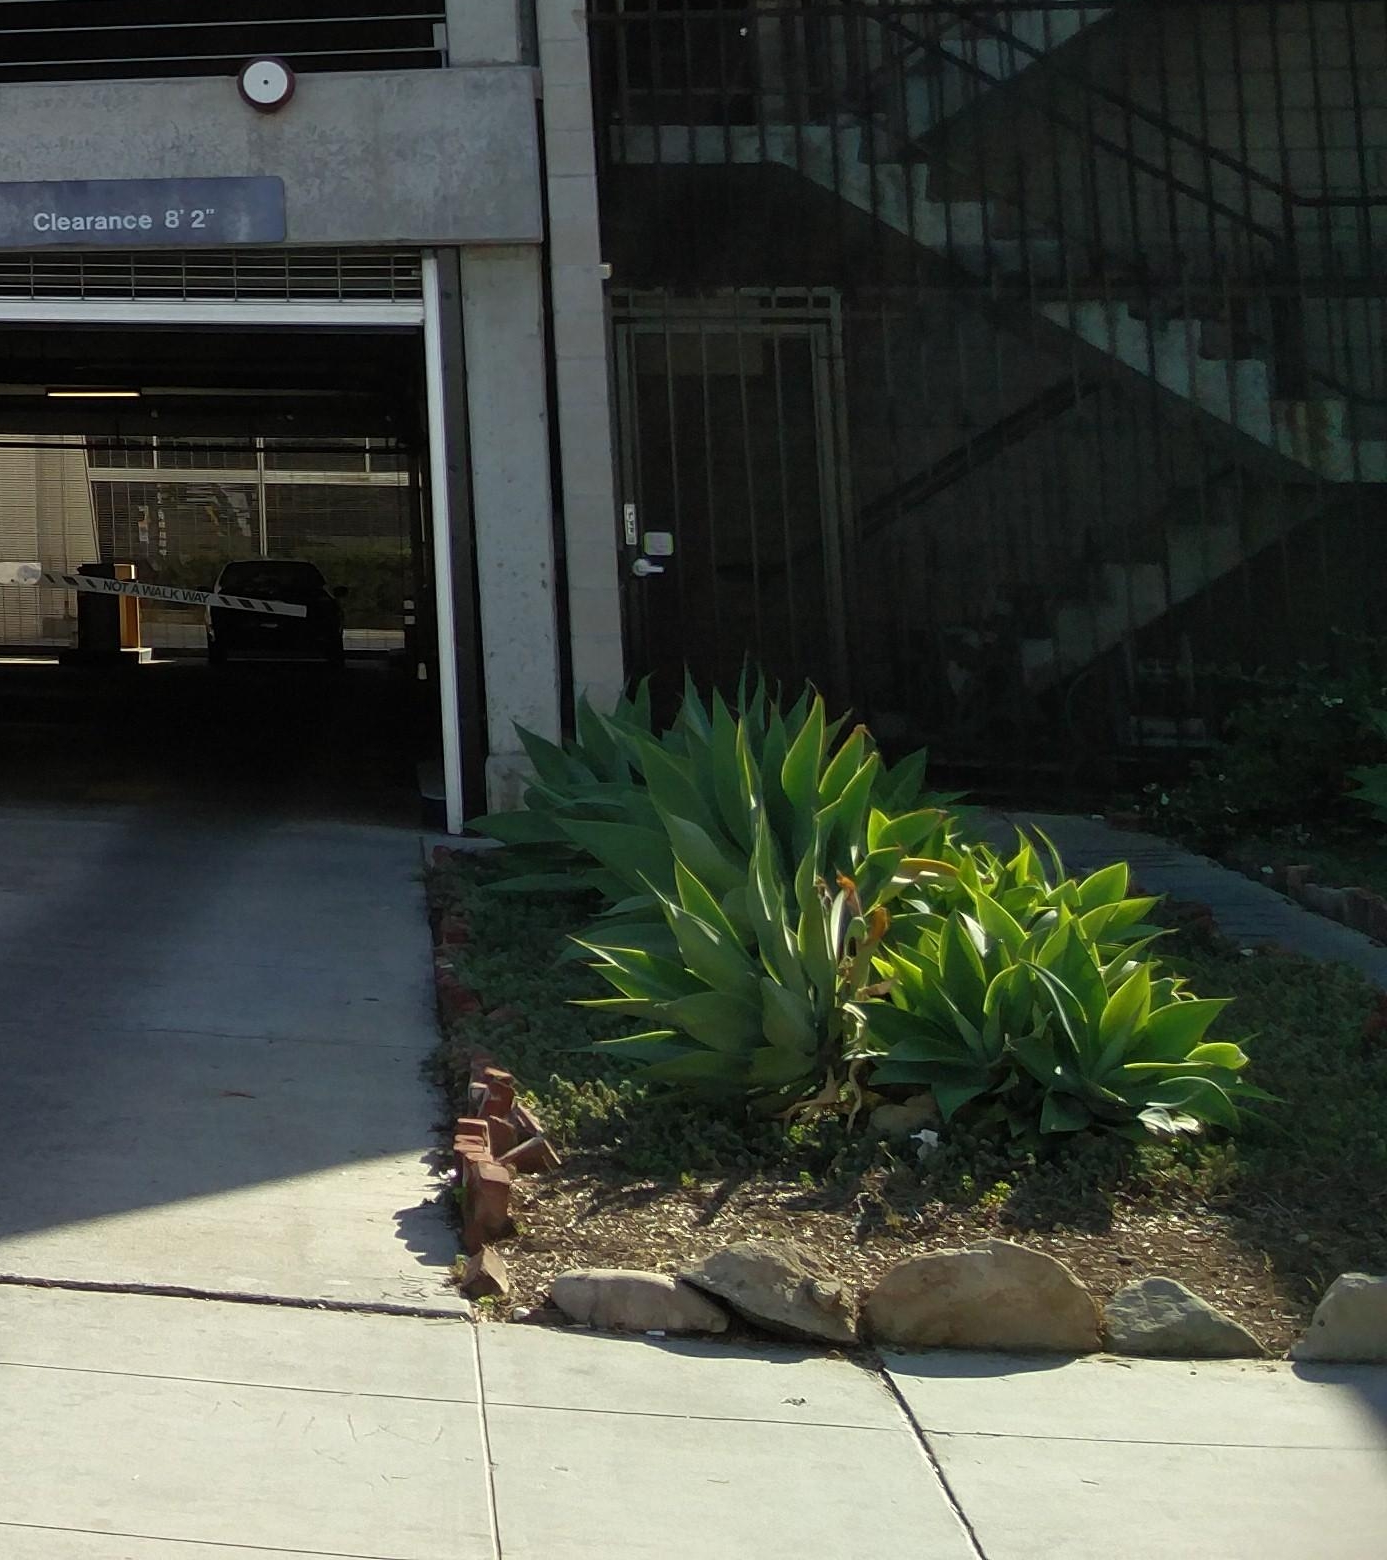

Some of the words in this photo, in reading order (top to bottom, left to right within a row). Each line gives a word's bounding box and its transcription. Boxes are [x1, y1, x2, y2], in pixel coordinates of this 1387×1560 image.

[33, 211, 152, 232] Clearance
[103, 581, 127, 592] NOT
[132, 584, 140, 594] A
[142, 585, 179, 599] WALK
[182, 591, 209, 603] WAY
